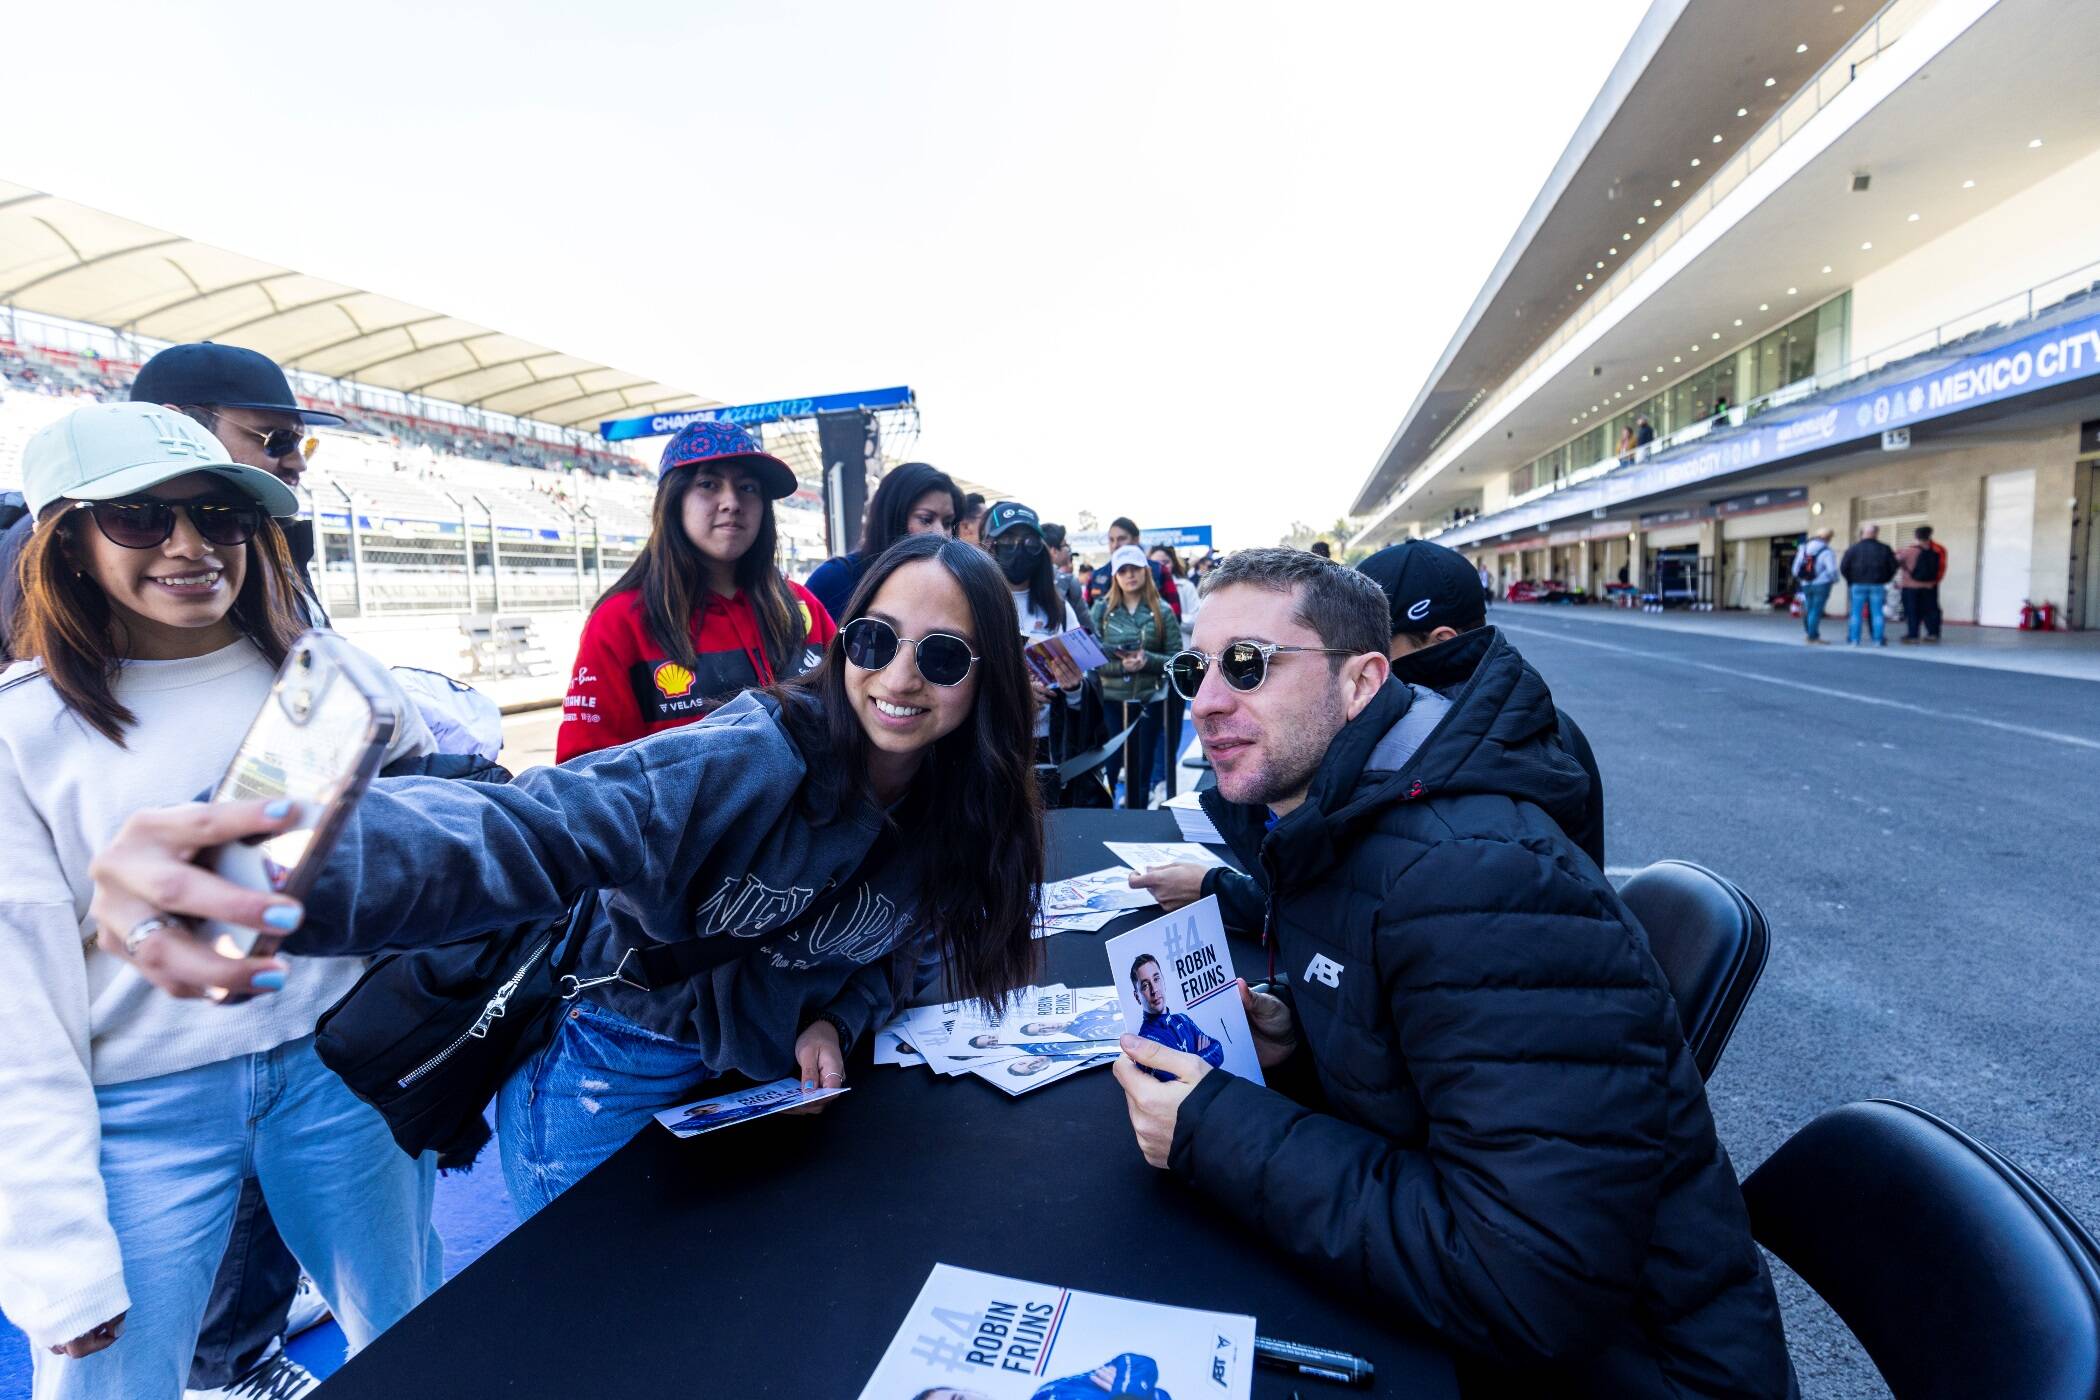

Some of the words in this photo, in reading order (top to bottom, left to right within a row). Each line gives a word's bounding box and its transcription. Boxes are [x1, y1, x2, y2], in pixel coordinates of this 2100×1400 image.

[1928, 351, 2033, 409] MEXICO
[671, 698, 703, 712] VELAS
[1175, 943, 1217, 980] ROBIN
[1181, 964, 1226, 1002] FRIJNS
[1037, 996, 1053, 1016] ROBIN
[965, 1300, 1019, 1368] ROBIN
[1001, 1301, 1054, 1375] FRIJNS
[1211, 1355, 1228, 1389] ABT
